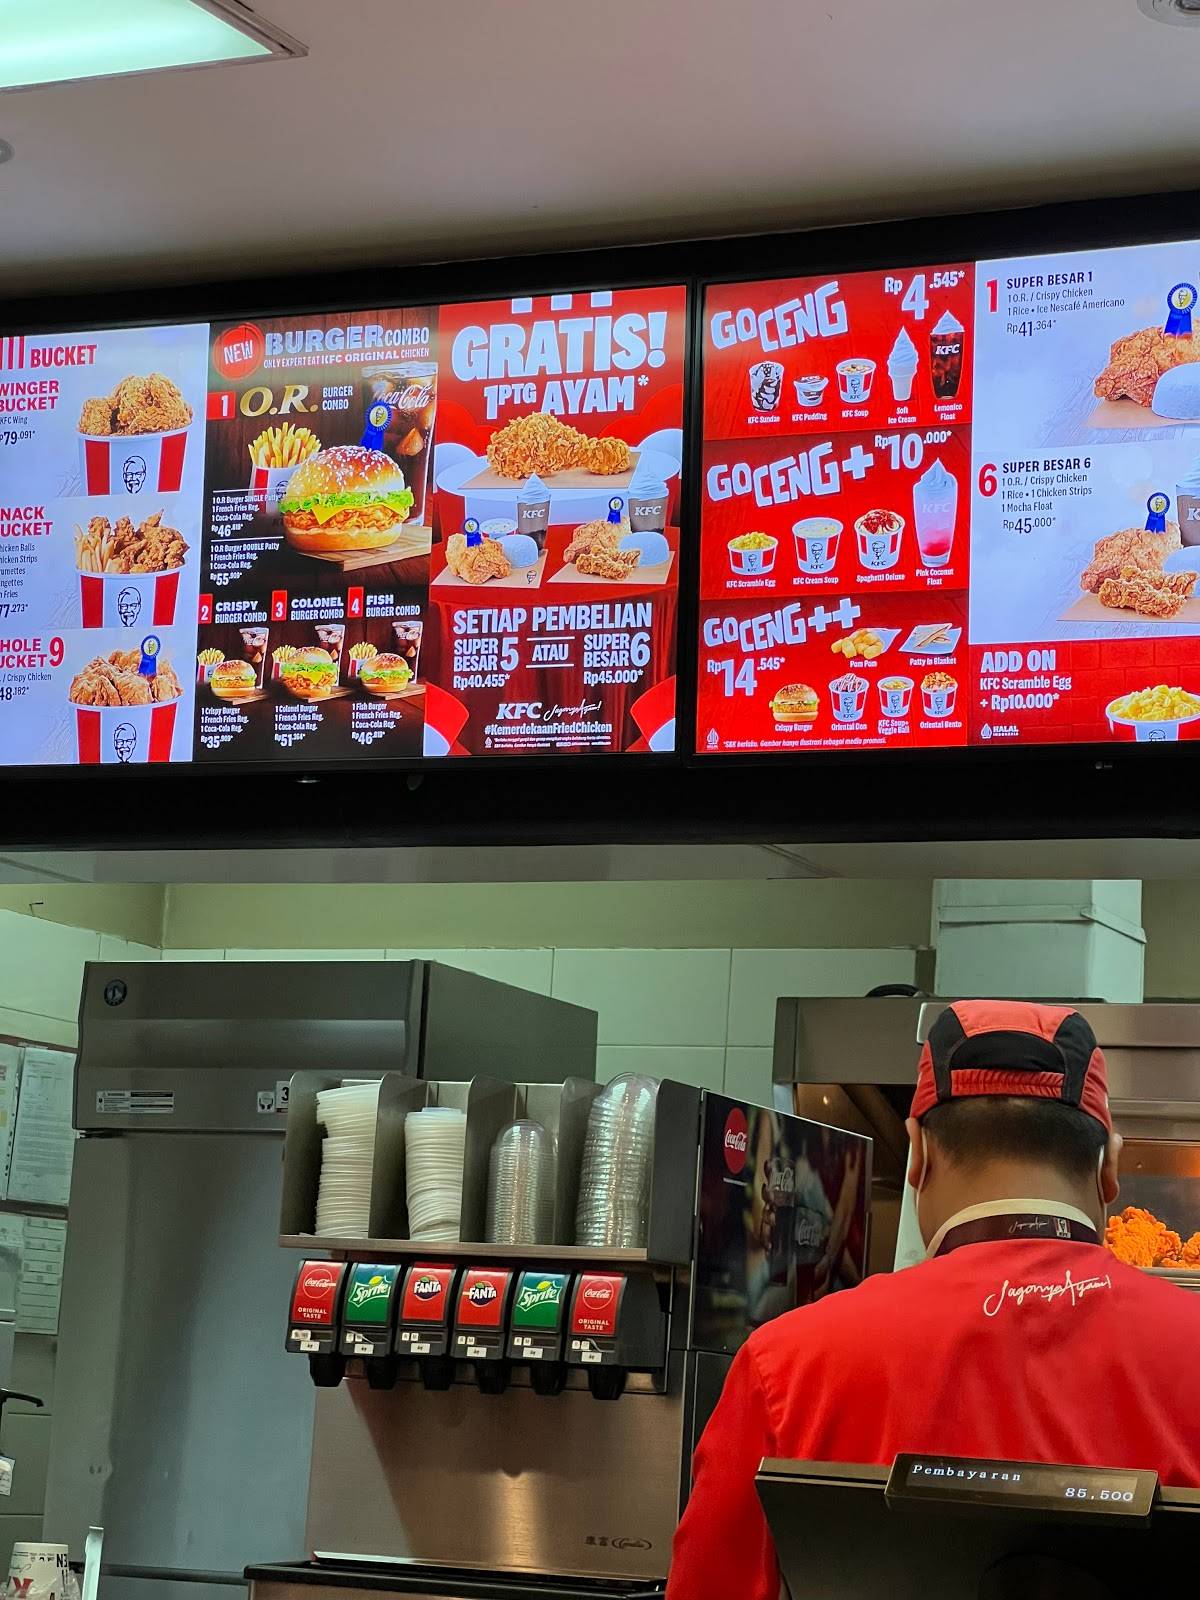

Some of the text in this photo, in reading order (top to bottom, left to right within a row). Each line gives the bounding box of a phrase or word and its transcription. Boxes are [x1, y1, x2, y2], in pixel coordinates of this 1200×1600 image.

[1007, 271, 1093, 290] SUPER BESAR 1
[986, 279, 998, 312] 1
[1007, 294, 1011, 303] 1
[1012, 294, 1029, 303] O.R.
[1035, 290, 1060, 302] Crispy
[1062, 288, 1093, 299] Chicken
[1007, 298, 1125, 316] 1 Rice Ice Nescafé Americano
[711, 281, 848, 352] GOCENG
[265, 324, 430, 356] BURGER COMBO
[452, 312, 668, 382] GRATIS!
[30, 344, 98, 368] BUCKET
[224, 340, 254, 365] NEW
[935, 344, 960, 355] KFC
[264, 348, 429, 369] ONLY EXPERT EAT KFC ORIGINAL CHICKEN
[0, 380, 60, 396] WINGER
[220, 394, 228, 416] 1
[240, 384, 353, 417] O.R. BURGER
[322, 399, 349, 410] COMBO
[12, 416, 28, 424] Wing
[748, 416, 758, 424] KFC
[792, 412, 828, 422] KFC Pudding
[842, 409, 869, 418] KFC Soup
[898, 415, 916, 424] Cream
[1002, 458, 1091, 474] SUPER BESAR 6
[978, 463, 998, 497] 6
[1002, 478, 1005, 486] 1
[1007, 477, 1024, 486] O.R.
[1030, 475, 1054, 487] Crispy
[1056, 474, 1088, 484] Chicken
[1002, 490, 1005, 499] 1
[1007, 490, 1024, 499] Rice
[1036, 486, 1068, 498] Chicken
[1069, 486, 1092, 497] Strips
[522, 508, 546, 519] KFC
[634, 506, 662, 516] KFC
[1001, 501, 1053, 512] 1 Mocha Float
[216, 600, 258, 612] CRISPY
[291, 597, 344, 608] COLONEL
[351, 598, 360, 614] 4
[366, 594, 394, 605] FISH
[201, 605, 209, 621] 2
[215, 612, 268, 624] BURGER COMBO
[275, 602, 284, 618] 3
[291, 608, 344, 621] BURGER COMBO
[366, 605, 420, 618] BURGER COMBO
[453, 602, 653, 635] SETIAP PEMBELIAN
[454, 638, 498, 655] SUPER
[584, 632, 630, 650] SUPER
[49, 636, 64, 667] 9
[453, 636, 519, 672] BESAR 5
[532, 643, 569, 662] ATAU
[584, 632, 651, 668] BESAR 6
[850, 660, 878, 668] Pom Pom
[980, 649, 1056, 674] ADD ON
[8, 672, 52, 682] Crispy Chicken
[980, 675, 1072, 691] KFC Scramble Egg
[496, 702, 543, 720] KFC
[484, 721, 612, 736] #KemerdekaanFriedChicken
[353, 1281, 388, 1303] Sprite
[414, 1281, 442, 1296] FANTA
[469, 1286, 497, 1301] FANTA
[520, 1286, 557, 1306] Sprite
[584, 1288, 612, 1299] Coca-Cola
[298, 1306, 328, 1315] ORIGINAL
[303, 1312, 322, 1320] TASTE
[578, 1318, 609, 1326] ORIGINAL
[584, 1324, 604, 1332] TASTE
[912, 1464, 1021, 1481] Pembayaran
